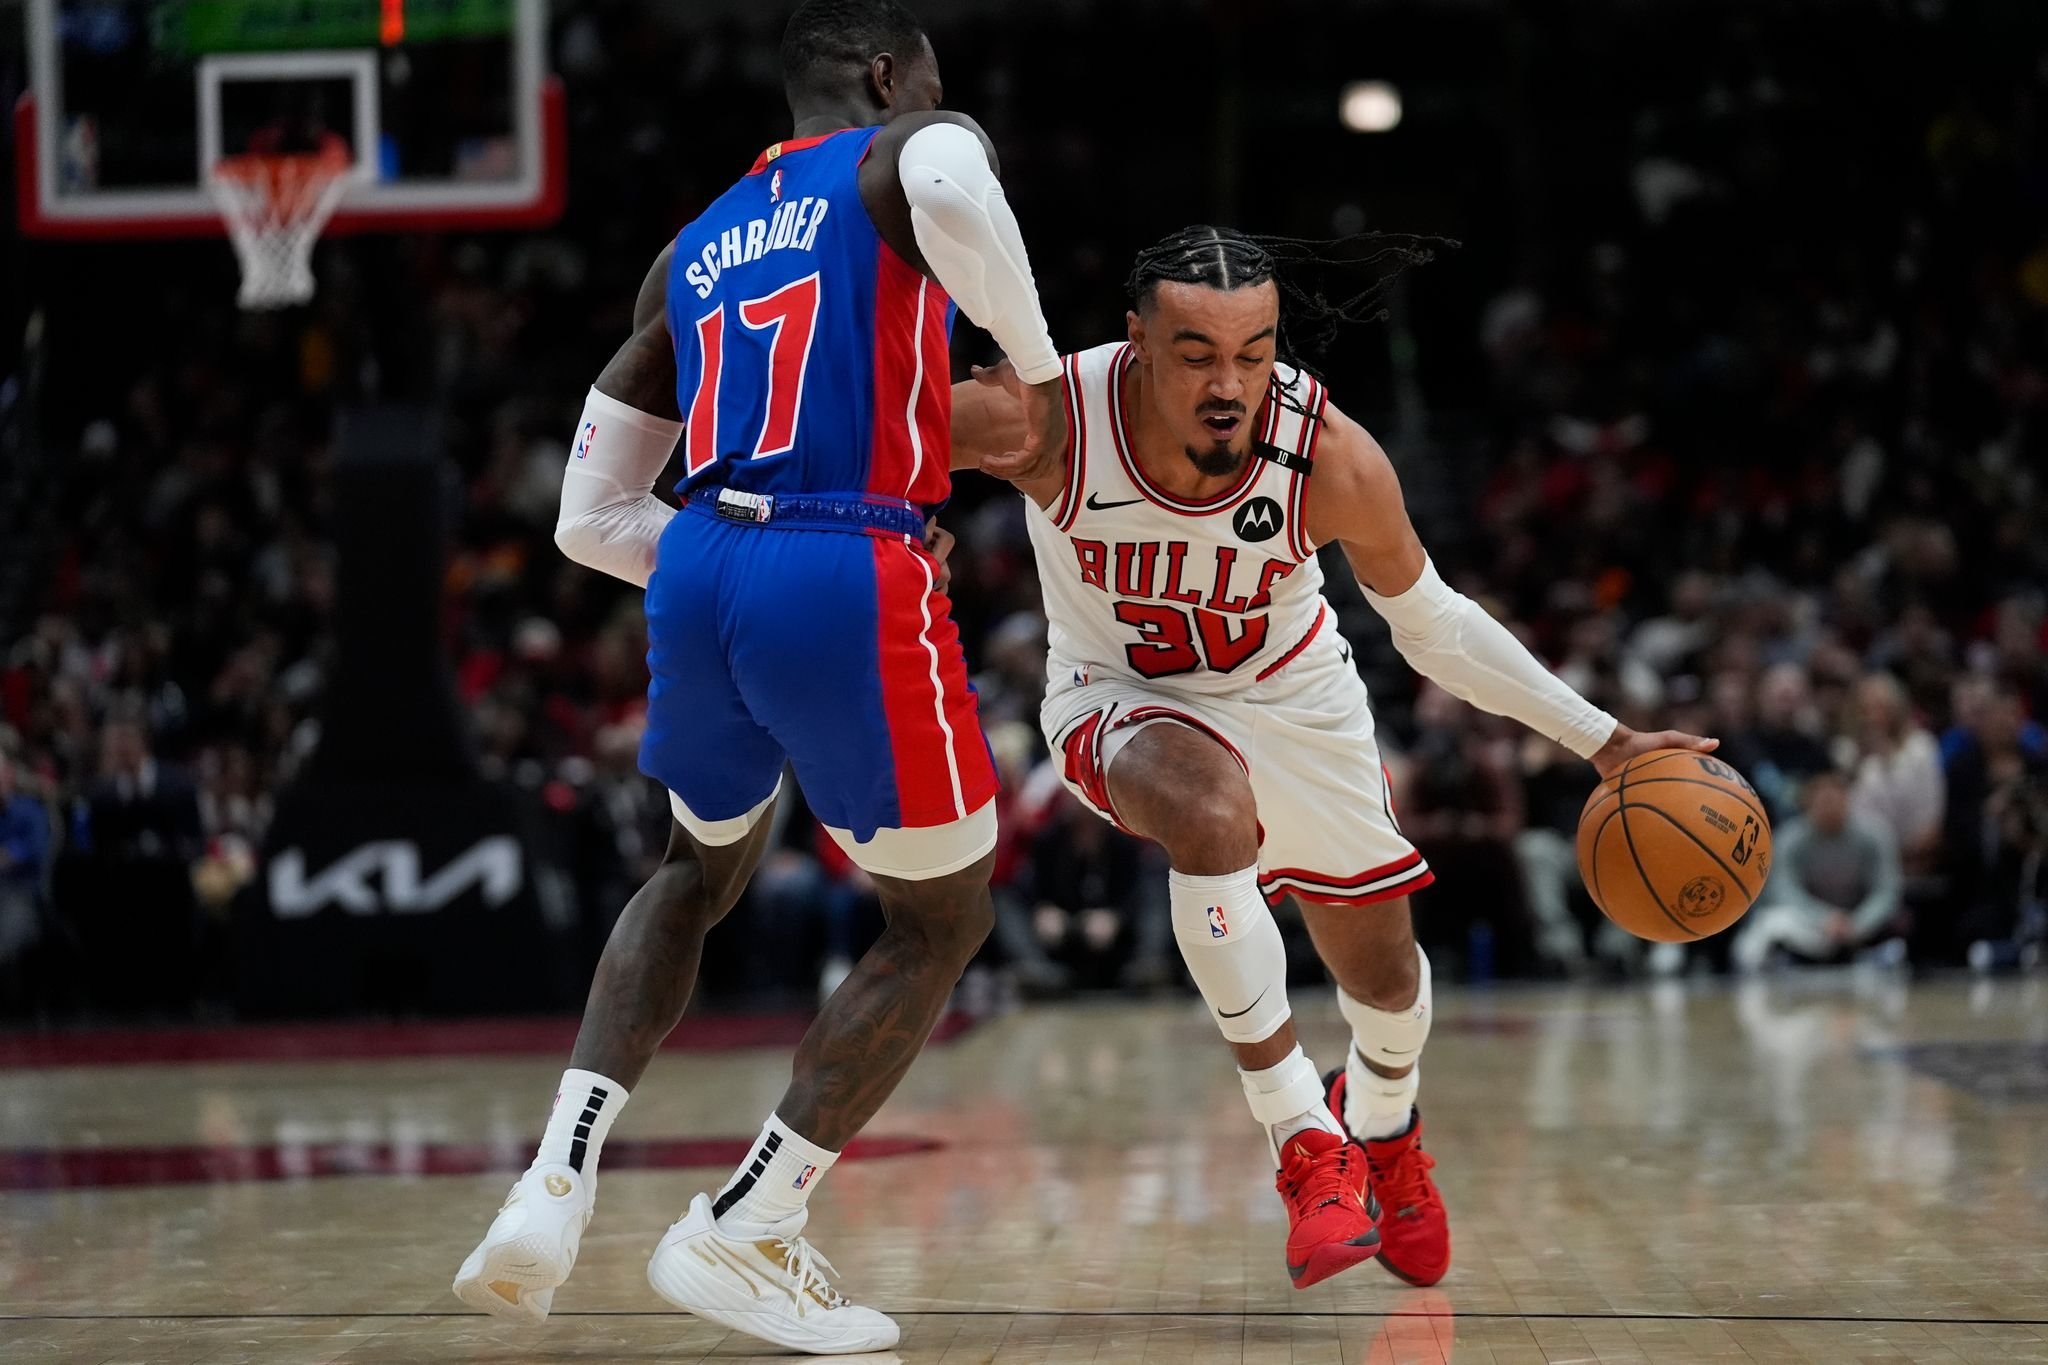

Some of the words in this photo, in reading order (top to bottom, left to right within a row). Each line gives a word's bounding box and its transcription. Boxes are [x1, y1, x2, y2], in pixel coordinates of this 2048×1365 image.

[686, 270, 821, 478] 17
[1276, 450, 1289, 465] 10
[1070, 536, 1298, 614] BULLS
[1112, 600, 1270, 680] 30
